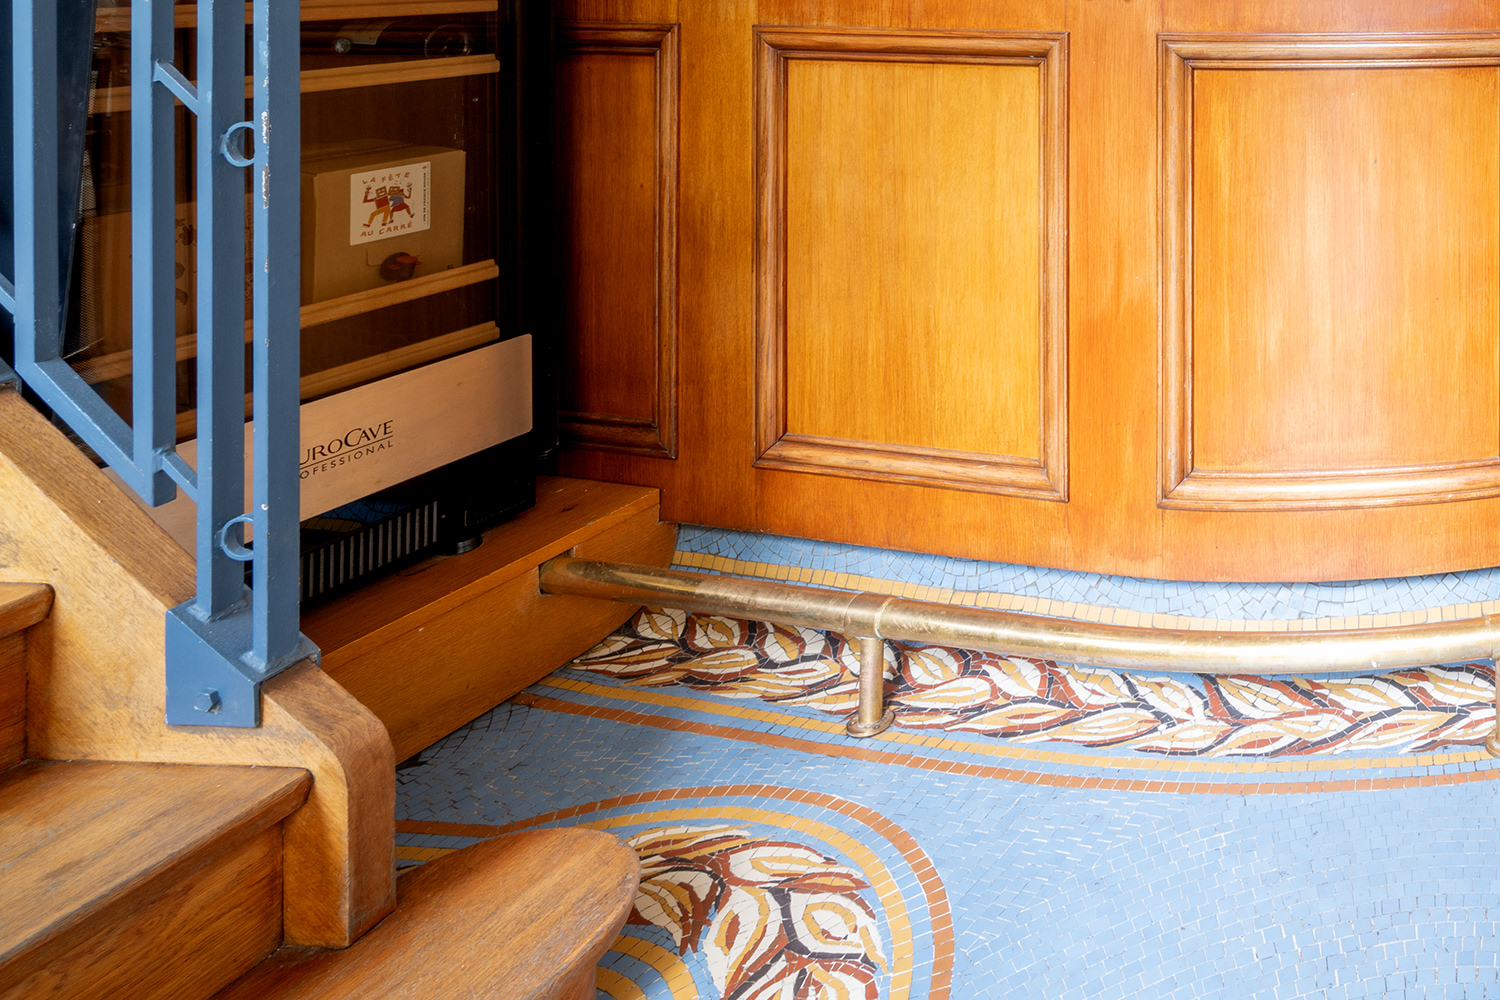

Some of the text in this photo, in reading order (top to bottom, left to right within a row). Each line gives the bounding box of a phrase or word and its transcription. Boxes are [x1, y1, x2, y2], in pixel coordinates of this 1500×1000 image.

[381, 172, 410, 182] FÊTE
[379, 221, 412, 235] CARRÉ
[299, 420, 394, 465] UROCAVE
[299, 440, 394, 479] OFESSIONAL
